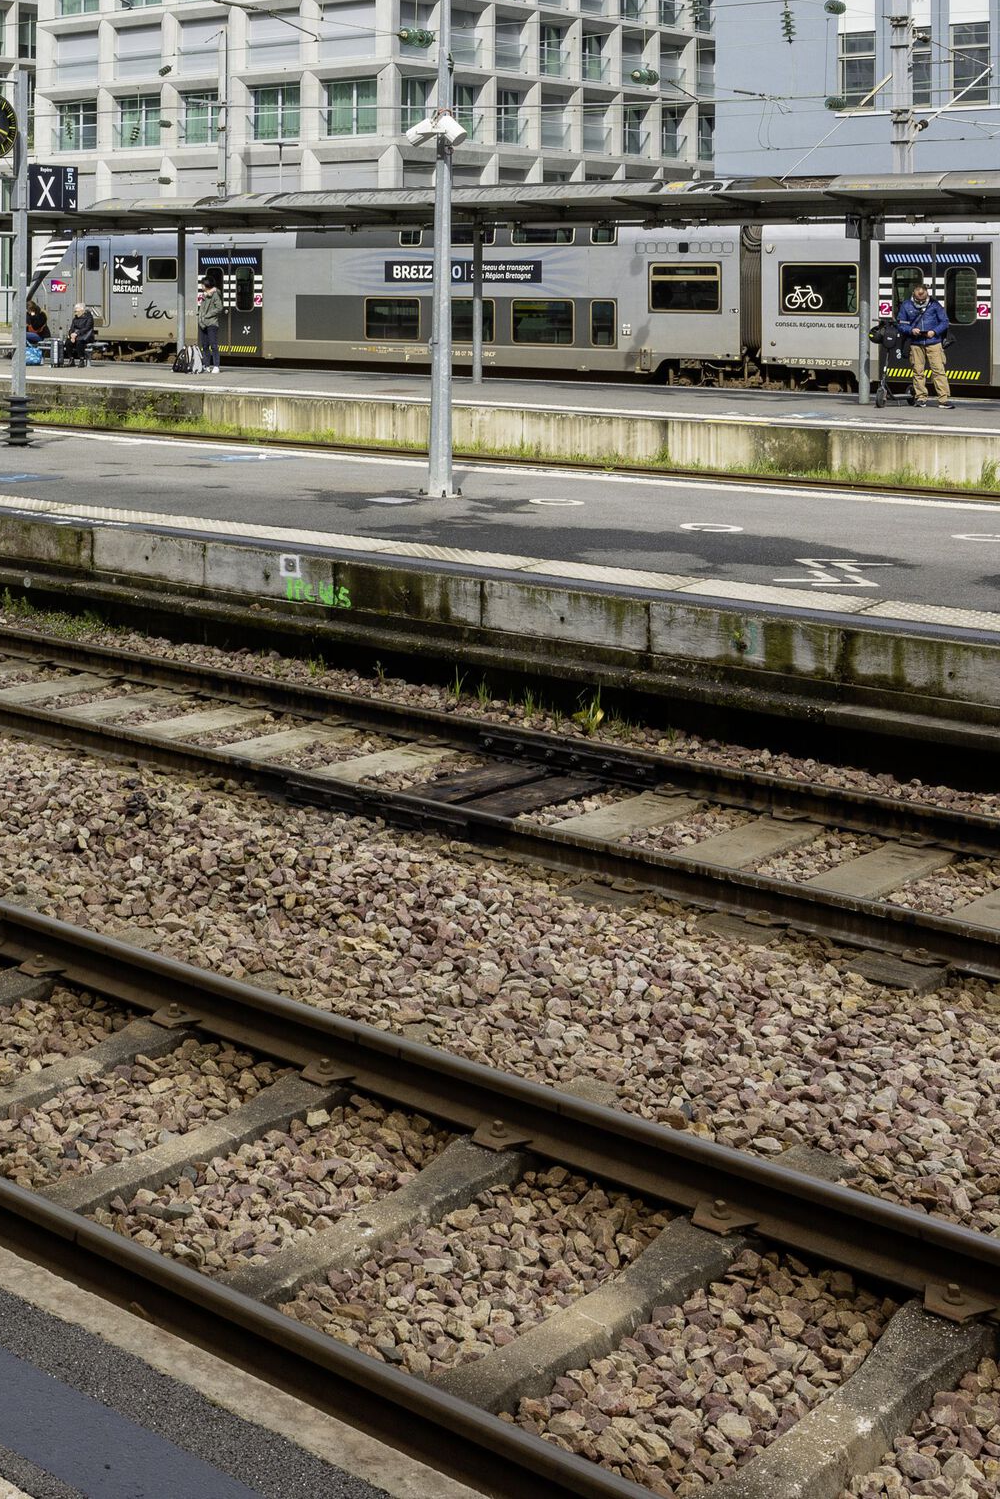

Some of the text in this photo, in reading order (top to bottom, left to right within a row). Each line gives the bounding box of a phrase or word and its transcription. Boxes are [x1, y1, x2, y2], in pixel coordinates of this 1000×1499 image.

[67, 172, 74, 183] 5
[36, 175, 56, 207] X
[498, 263, 506, 271] de
[506, 263, 535, 273] transport
[485, 271, 505, 281] Région
[505, 272, 532, 281] Bretagne
[51, 284, 67, 292] SNCF
[112, 285, 143, 293] BRETAGNE
[881, 303, 890, 315] 2
[979, 304, 988, 316] 2
